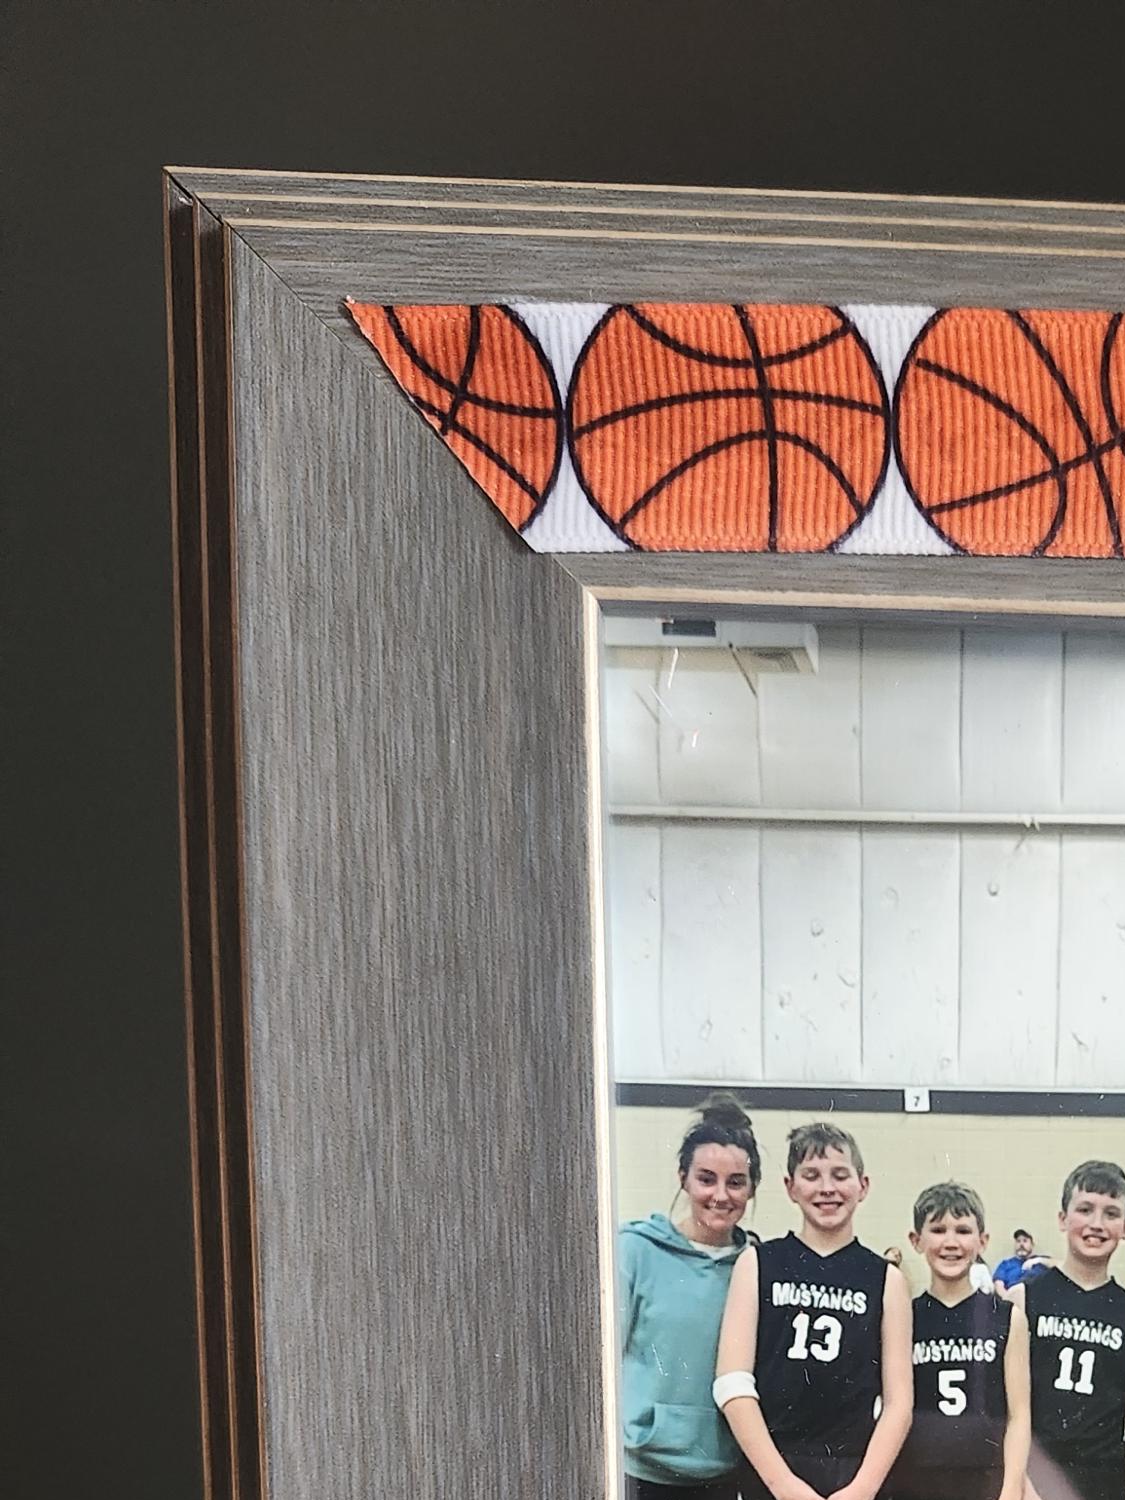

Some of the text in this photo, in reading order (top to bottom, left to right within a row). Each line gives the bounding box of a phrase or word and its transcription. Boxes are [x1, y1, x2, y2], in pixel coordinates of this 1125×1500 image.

[772, 1282, 867, 1314] MUSTANGS
[787, 1313, 842, 1361] 13
[1037, 1315, 1122, 1350] MUSTANGS
[938, 1369, 967, 1416] 5
[1054, 1346, 1095, 1394] 11
